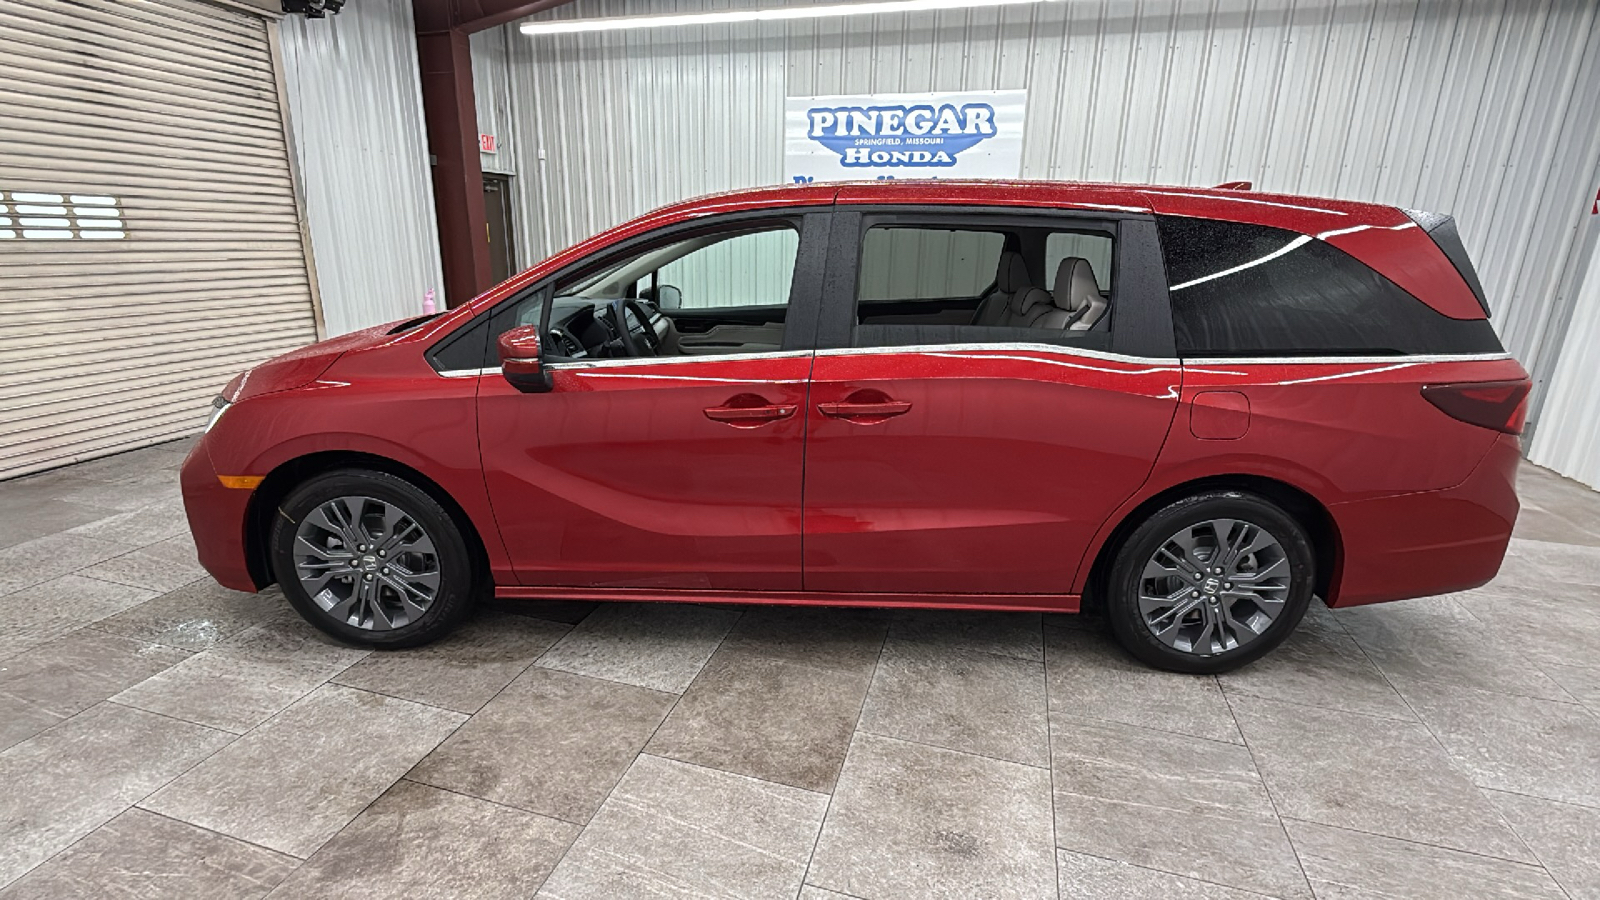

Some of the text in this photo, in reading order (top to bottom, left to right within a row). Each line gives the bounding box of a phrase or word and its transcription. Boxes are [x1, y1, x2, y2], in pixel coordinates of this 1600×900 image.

[811, 108, 993, 137] PINEGAR
[481, 135, 495, 151] EXIT
[844, 147, 952, 164] HONDA
